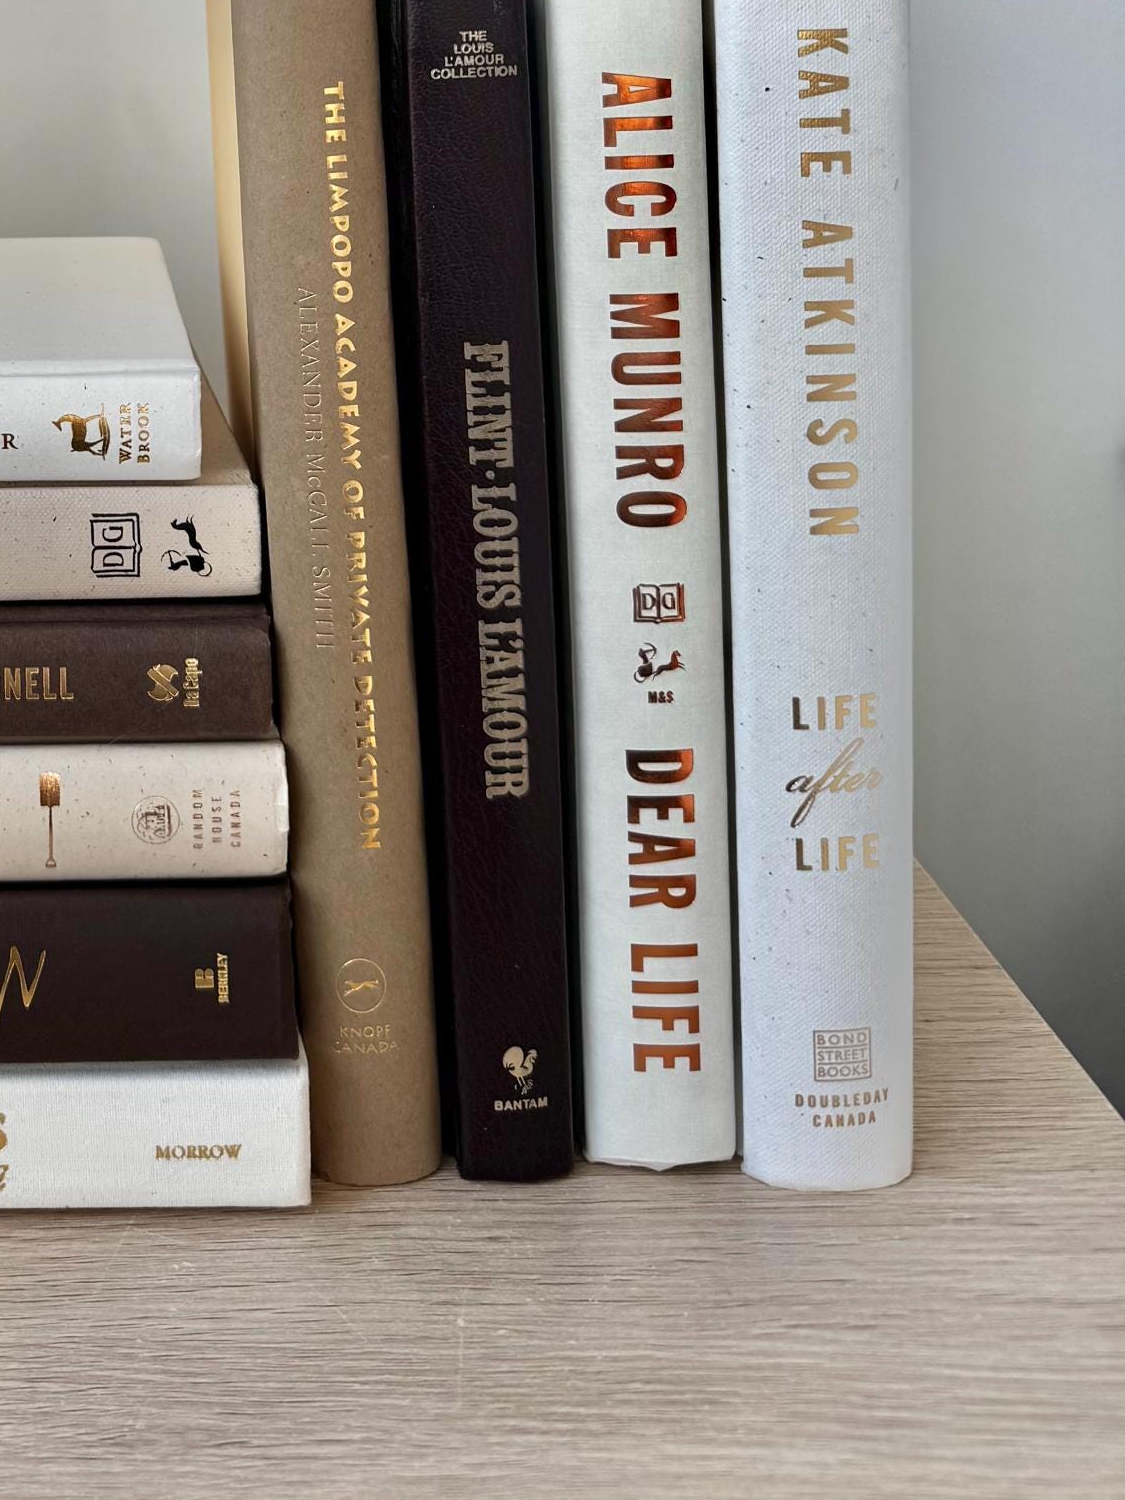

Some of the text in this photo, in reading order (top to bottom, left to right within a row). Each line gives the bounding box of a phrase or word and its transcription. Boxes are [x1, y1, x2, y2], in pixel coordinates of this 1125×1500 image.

[453, 41, 494, 55] LOUIS
[459, 30, 488, 42] THE
[430, 65, 518, 80] COLLECTION
[444, 53, 504, 67] L'AMOUR
[601, 71, 687, 528] ALICE MUNRO
[797, 27, 860, 536] KATE ATKINSON
[118, 402, 133, 465] WATER
[136, 402, 152, 464] BROOK
[297, 287, 325, 444] ALEXANDER
[311, 564, 335, 651] SMITH
[321, 81, 383, 851] THE LIMPOPO ACADEMY OF PRIVATE DETECTION
[463, 340, 531, 800] FLINT LOUIS L'AMOUR
[647, 690, 675, 704] M&S
[792, 693, 877, 732] LIFE
[785, 736, 884, 829] after
[193, 789, 204, 850] RANDOM
[211, 796, 222, 844] HOUSE
[230, 789, 241, 848] CANADA
[794, 832, 881, 872] LIFE
[625, 748, 702, 1073] DEAR LIFE
[216, 952, 230, 1004] BERKLEY
[339, 1024, 392, 1038] KNOPF
[816, 1031, 868, 1046] BOND
[817, 1047, 867, 1062] STREET
[817, 1063, 869, 1078] BOOKS
[494, 1097, 548, 1112] BANTAM
[795, 1087, 889, 1108] DOUBLEDAY
[812, 1110, 876, 1128] CANADA
[155, 1143, 242, 1161] MORROW
